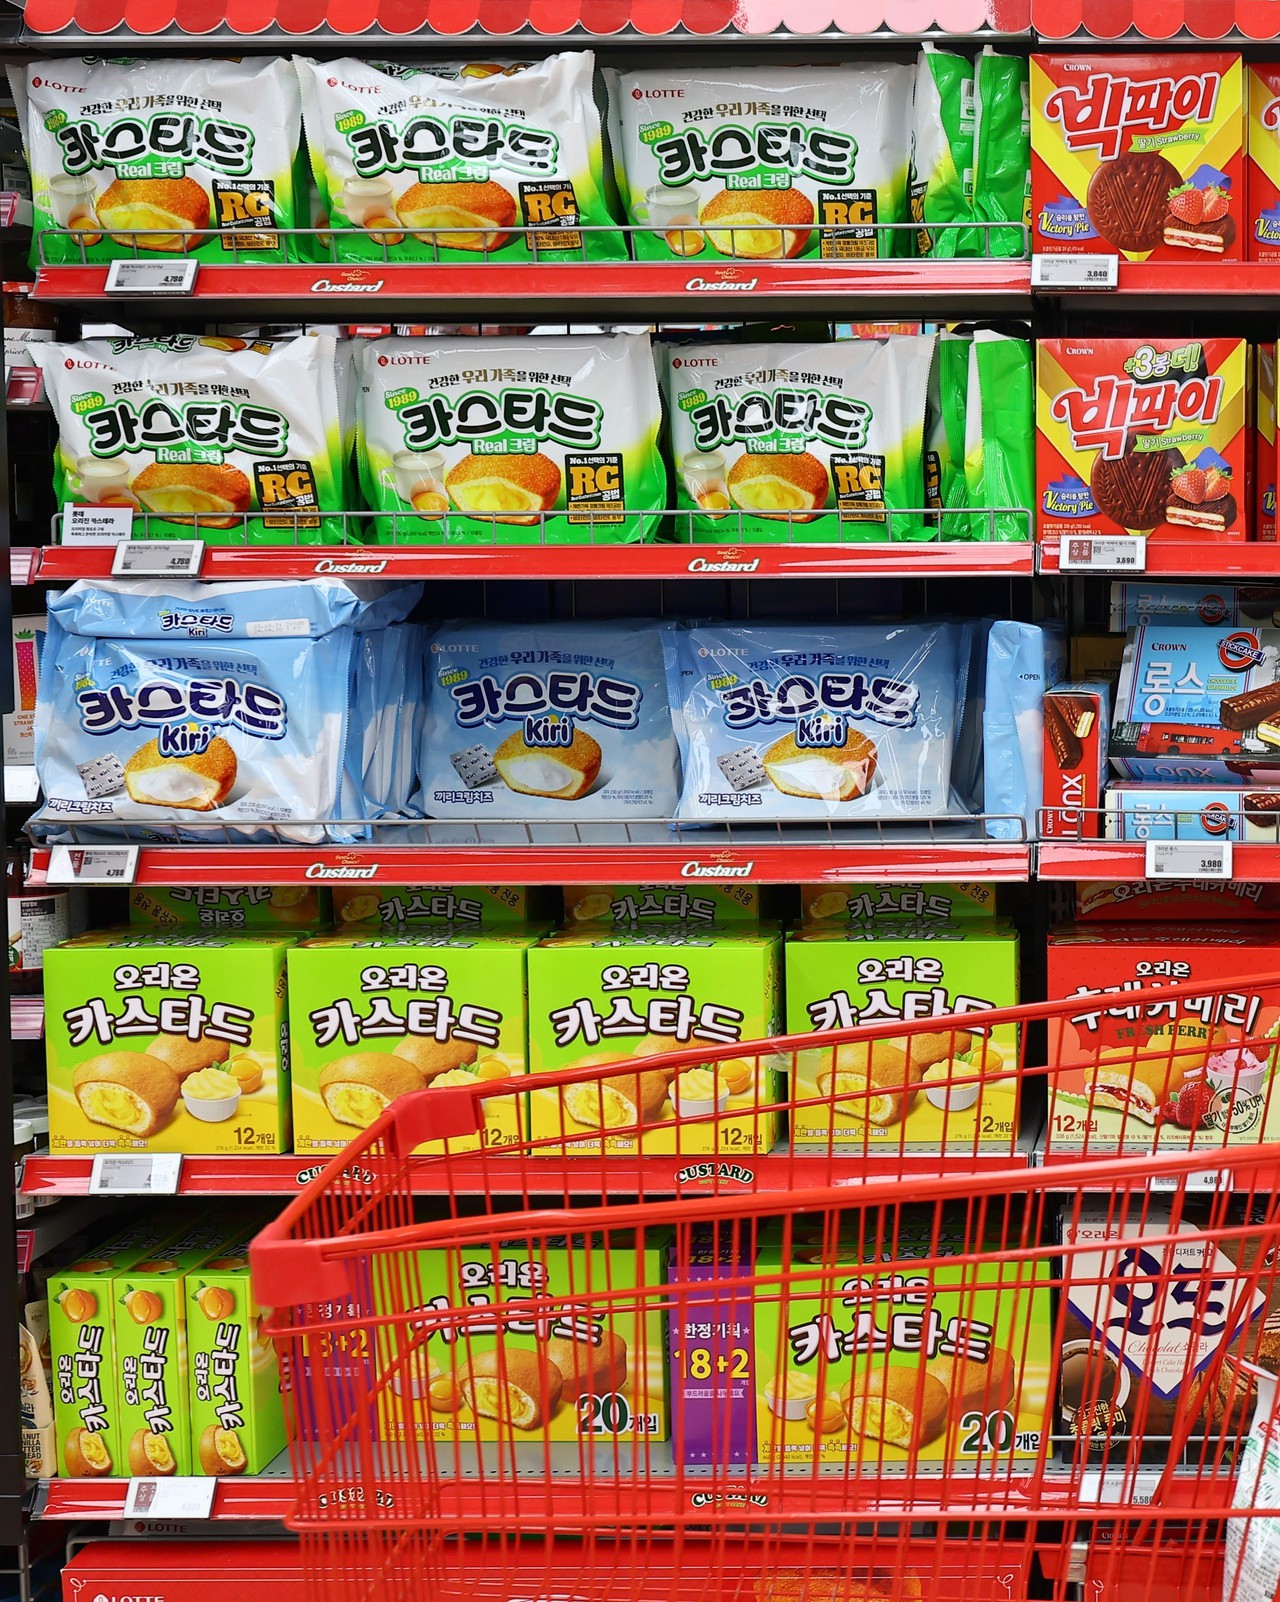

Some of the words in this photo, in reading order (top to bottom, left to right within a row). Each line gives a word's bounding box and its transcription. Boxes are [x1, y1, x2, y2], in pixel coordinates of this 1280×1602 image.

[1064, 63, 1092, 72] CROWN
[646, 89, 684, 98] LOTTE
[681, 108, 714, 123] 건강한
[715, 103, 742, 117] 우리
[744, 101, 780, 117] 가족을
[783, 105, 804, 118] 위한
[804, 107, 827, 122] 선택
[1045, 72, 1220, 161] 빅파이
[58, 117, 249, 167] 카스타드
[639, 123, 660, 134] Since
[642, 125, 672, 143] 1989
[1138, 137, 1155, 149] 딸기
[1156, 132, 1199, 145] Strawberry
[351, 121, 552, 168] 카스타드
[656, 128, 851, 177] 카스타드
[729, 174, 761, 188] Real
[763, 174, 790, 188] 크림
[524, 193, 576, 222] RC
[1038, 211, 1072, 234] Victory
[1073, 221, 1089, 233] Pie
[310, 280, 383, 293] Custard
[685, 278, 758, 292] Custard
[391, 356, 430, 365] LOTTE
[684, 358, 718, 367] LOTTE
[428, 374, 460, 389] 건강한
[462, 369, 488, 383] 우리
[489, 368, 526, 383] 가족을
[528, 371, 549, 384] 위한
[550, 373, 572, 387] 선택
[88, 403, 282, 448] 카스타드
[402, 394, 597, 442] 카스타드
[694, 391, 865, 442] 카스타드
[1051, 375, 1221, 460] 빅파이
[570, 466, 620, 494] RC
[687, 558, 760, 573] Custard
[162, 613, 234, 630] 카스타드
[1151, 642, 1187, 652] CROWN
[1220, 639, 1263, 661] STICKCAKE
[1024, 673, 1040, 681] OPEN
[1141, 661, 1204, 716] 롱스
[79, 681, 286, 736] 카스타드
[453, 674, 637, 721] 카스타드
[722, 675, 918, 723] 카스타드
[525, 717, 569, 744] Kiri
[799, 718, 842, 745] Kiri
[434, 790, 493, 804] 끼리크림치즈
[699, 793, 761, 806] 끼리크림치즈
[306, 864, 378, 879] Custard
[681, 862, 755, 878] Custard
[1201, 859, 1222, 868] 3,980
[612, 895, 715, 920] 카스타드
[849, 893, 952, 917] 카스타드
[115, 964, 200, 990] 오리온
[361, 964, 447, 991] 오리온
[602, 964, 688, 991] 오리온
[858, 957, 943, 984] 오리온
[1136, 961, 1190, 977] 오리온
[66, 998, 253, 1045] 카스타드
[310, 998, 501, 1046] 카스타드
[552, 997, 742, 1044] 카스타드
[1251, 1094, 1266, 1108] UP!
[233, 1127, 275, 1145] 12개입
[721, 1127, 762, 1146] 12개입
[1053, 1115, 1097, 1131] 12개입
[675, 1164, 754, 1183] CUSTARD
[460, 1260, 548, 1288] 오리온
[843, 1276, 935, 1306] 오리온
[790, 1311, 992, 1363] 카스타드
[195, 1352, 211, 1401] 오리온
[211, 1324, 243, 1431] 카스타드
[674, 1349, 750, 1380] 18+2
[58, 1354, 76, 1404] 오리온
[75, 1325, 109, 1432] 카스타드
[124, 1356, 140, 1405] 오리온
[141, 1326, 174, 1434] 카스타드
[576, 1394, 659, 1434] 20개입
[960, 1411, 1042, 1452] 20개입
[148, 1523, 187, 1534] LOTTE
